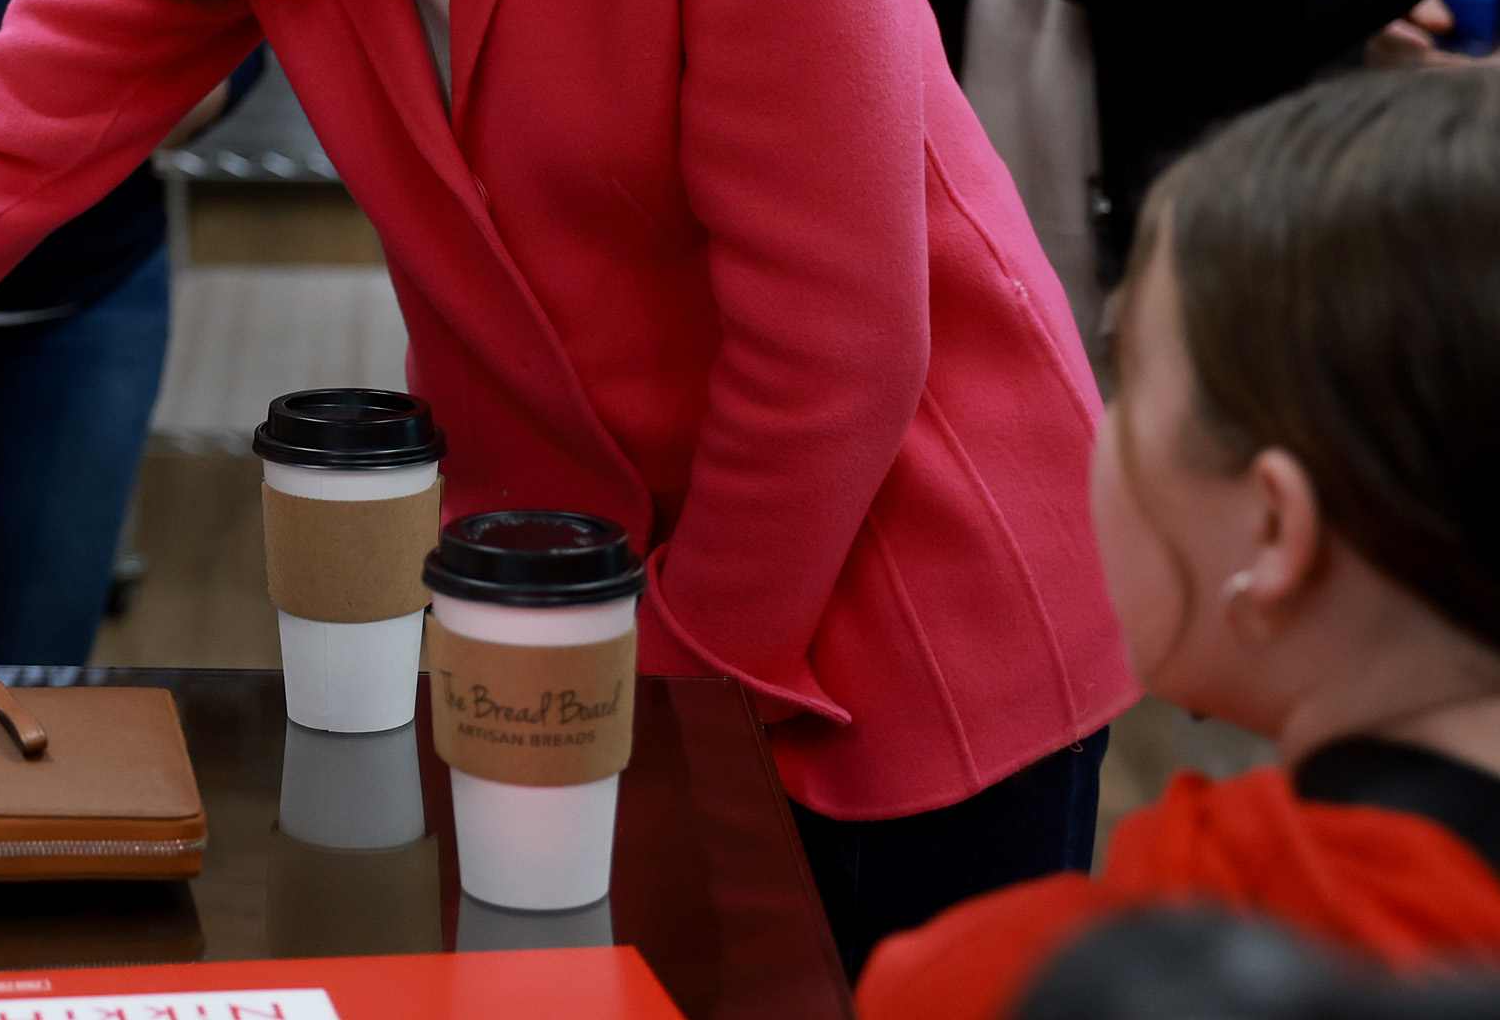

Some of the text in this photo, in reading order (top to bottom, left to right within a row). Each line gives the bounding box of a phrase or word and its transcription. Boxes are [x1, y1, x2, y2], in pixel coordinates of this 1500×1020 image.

[439, 669, 624, 727] The Bread Board
[456, 722, 598, 748] ARTISAN BREADS
